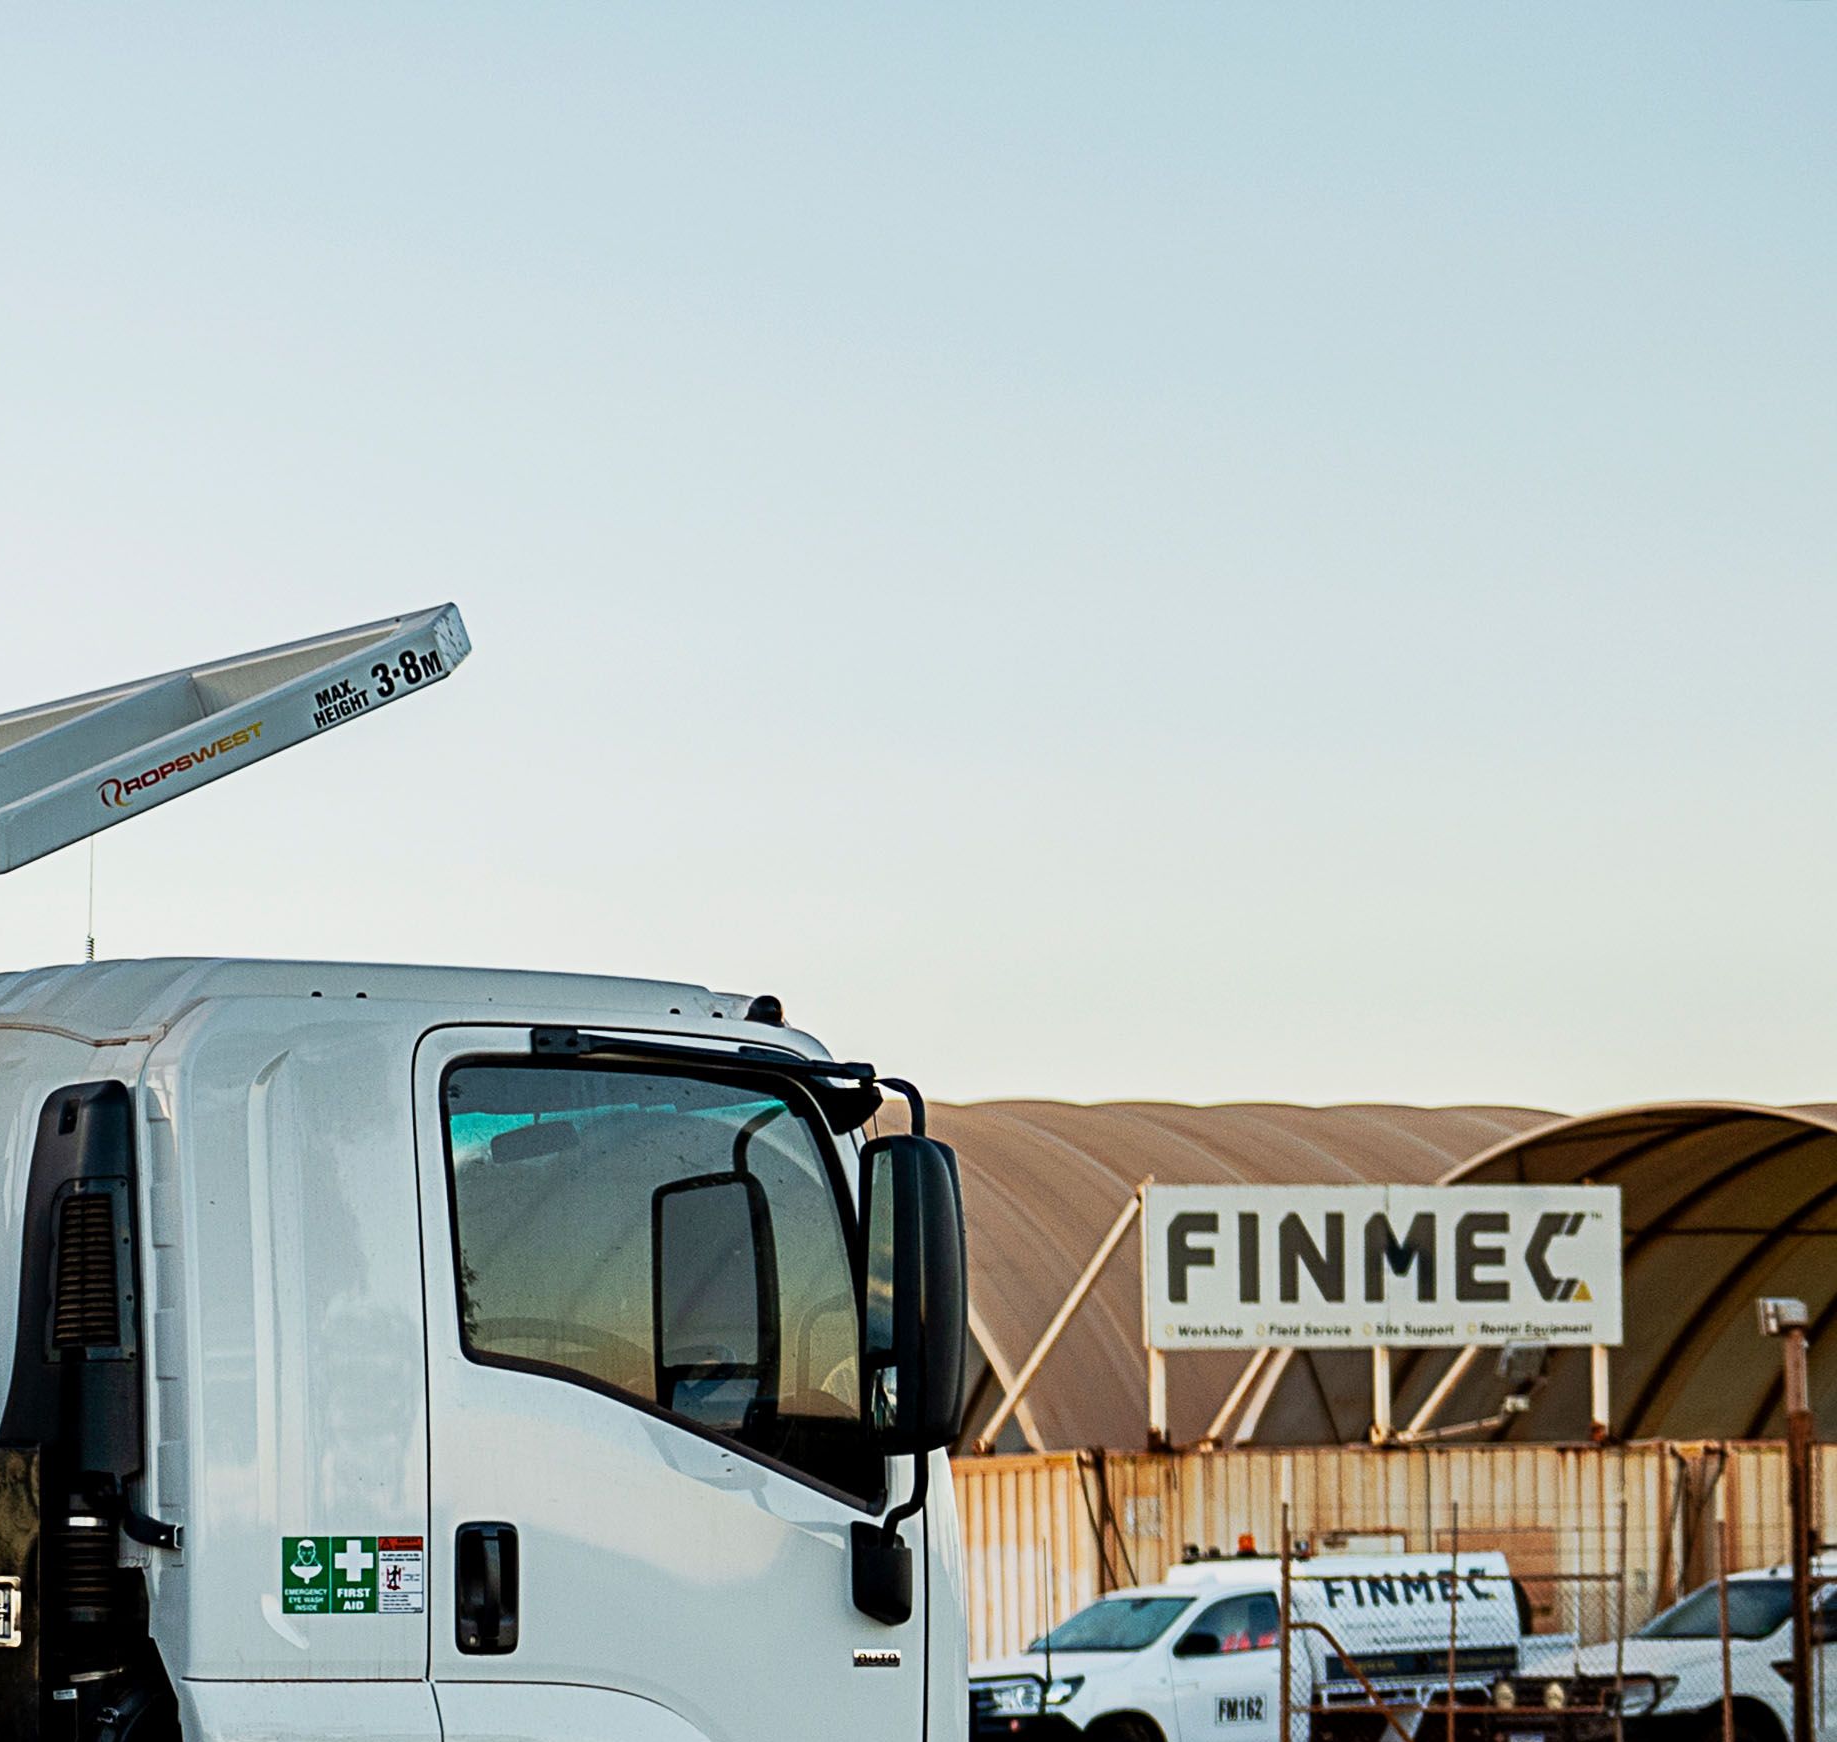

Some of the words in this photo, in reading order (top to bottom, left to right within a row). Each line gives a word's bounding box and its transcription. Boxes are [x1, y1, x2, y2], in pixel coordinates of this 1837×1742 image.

[315, 679, 358, 709] MAX.
[313, 690, 371, 730] HEIGHT
[1166, 1211, 1593, 1304] FINMEC
[1177, 1325, 1244, 1338] Workshop
[1269, 1323, 1301, 1336] Field
[1304, 1323, 1352, 1336] Service
[1376, 1324, 1400, 1336] Site
[1404, 1324, 1455, 1337] Support
[1480, 1323, 1521, 1335] Rental
[1524, 1322, 1592, 1337] Equipment
[284, 1588, 327, 1596] EMERGENCY
[336, 1588, 371, 1598] FIRST
[1324, 1568, 1497, 1608] FINMEC
[303, 1596, 324, 1604] WASH
[343, 1600, 365, 1611] AID
[857, 1653, 898, 1665] AUTO
[1218, 1696, 1264, 1722] FM162
